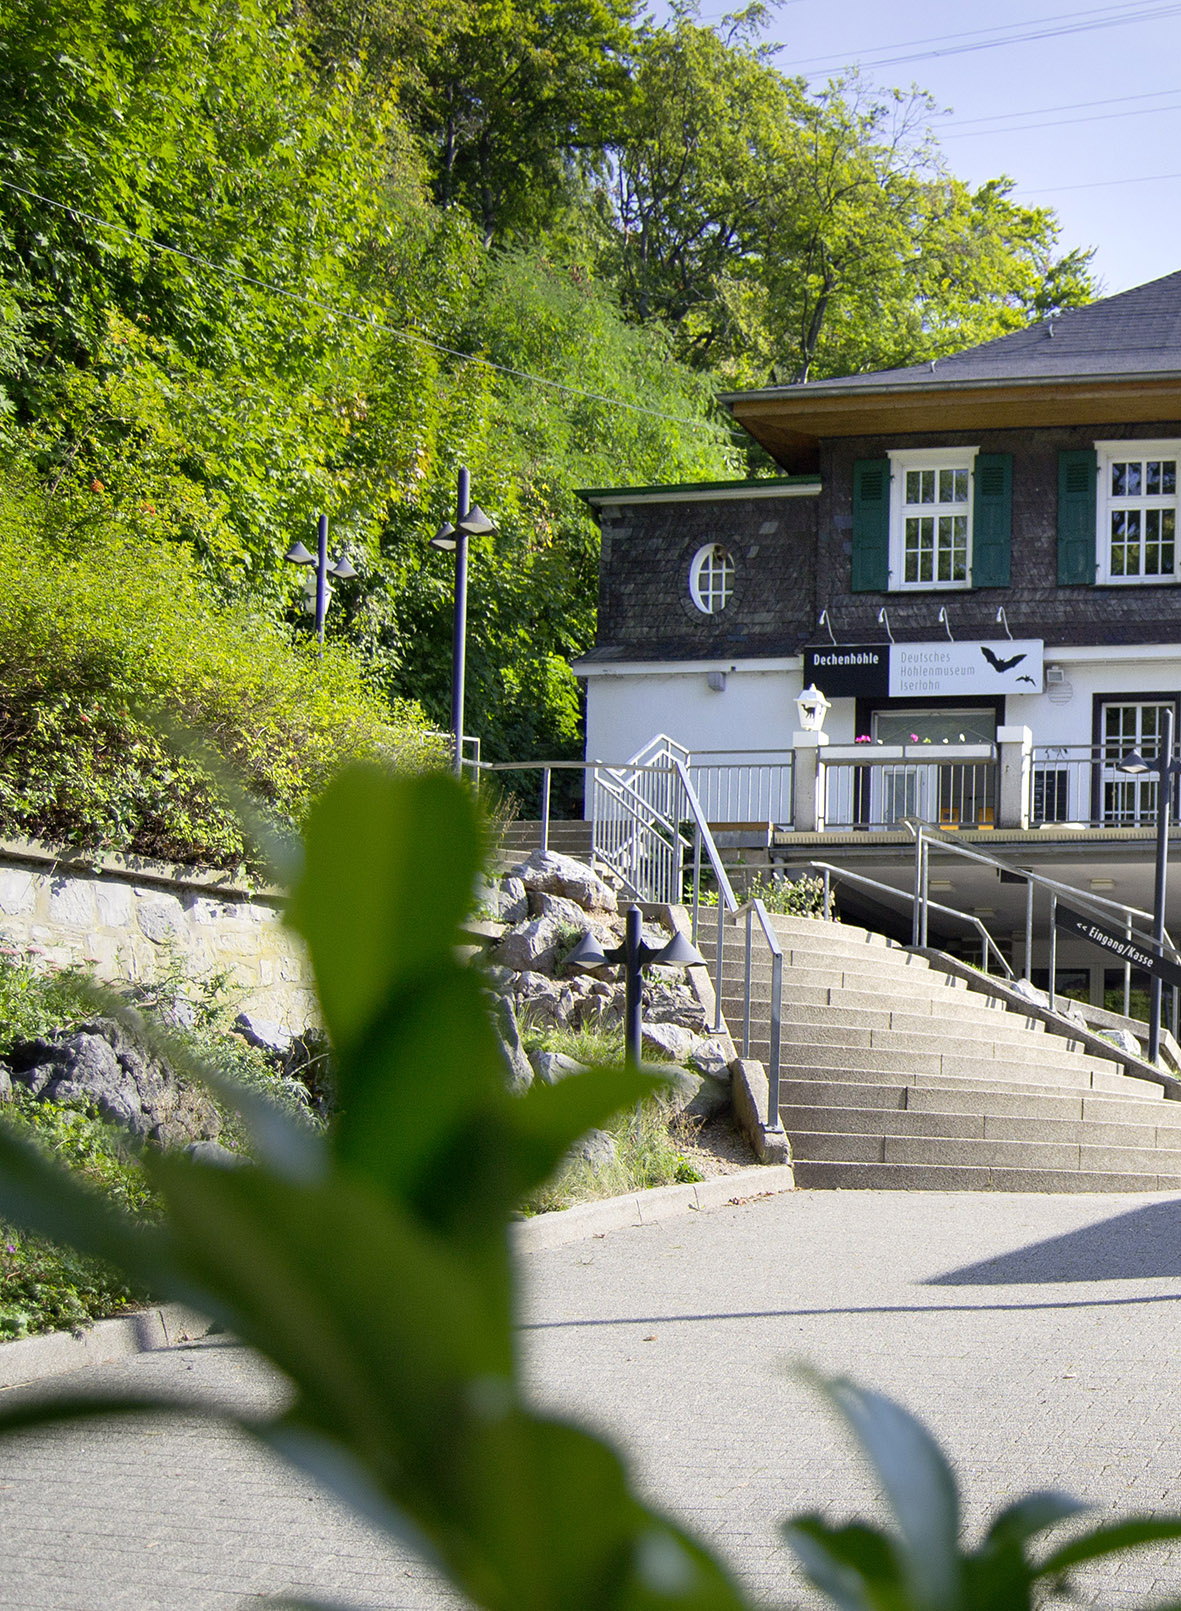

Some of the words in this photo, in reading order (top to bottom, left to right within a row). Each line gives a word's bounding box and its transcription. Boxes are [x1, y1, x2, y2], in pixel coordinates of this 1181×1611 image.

[813, 652, 879, 665] Dechenhöhle
[901, 651, 951, 663] Deutsches
[901, 665, 975, 677] Höhlenmuseum
[901, 679, 940, 691] Iserlohn
[1088, 926, 1154, 968] Eingang/Kasse
